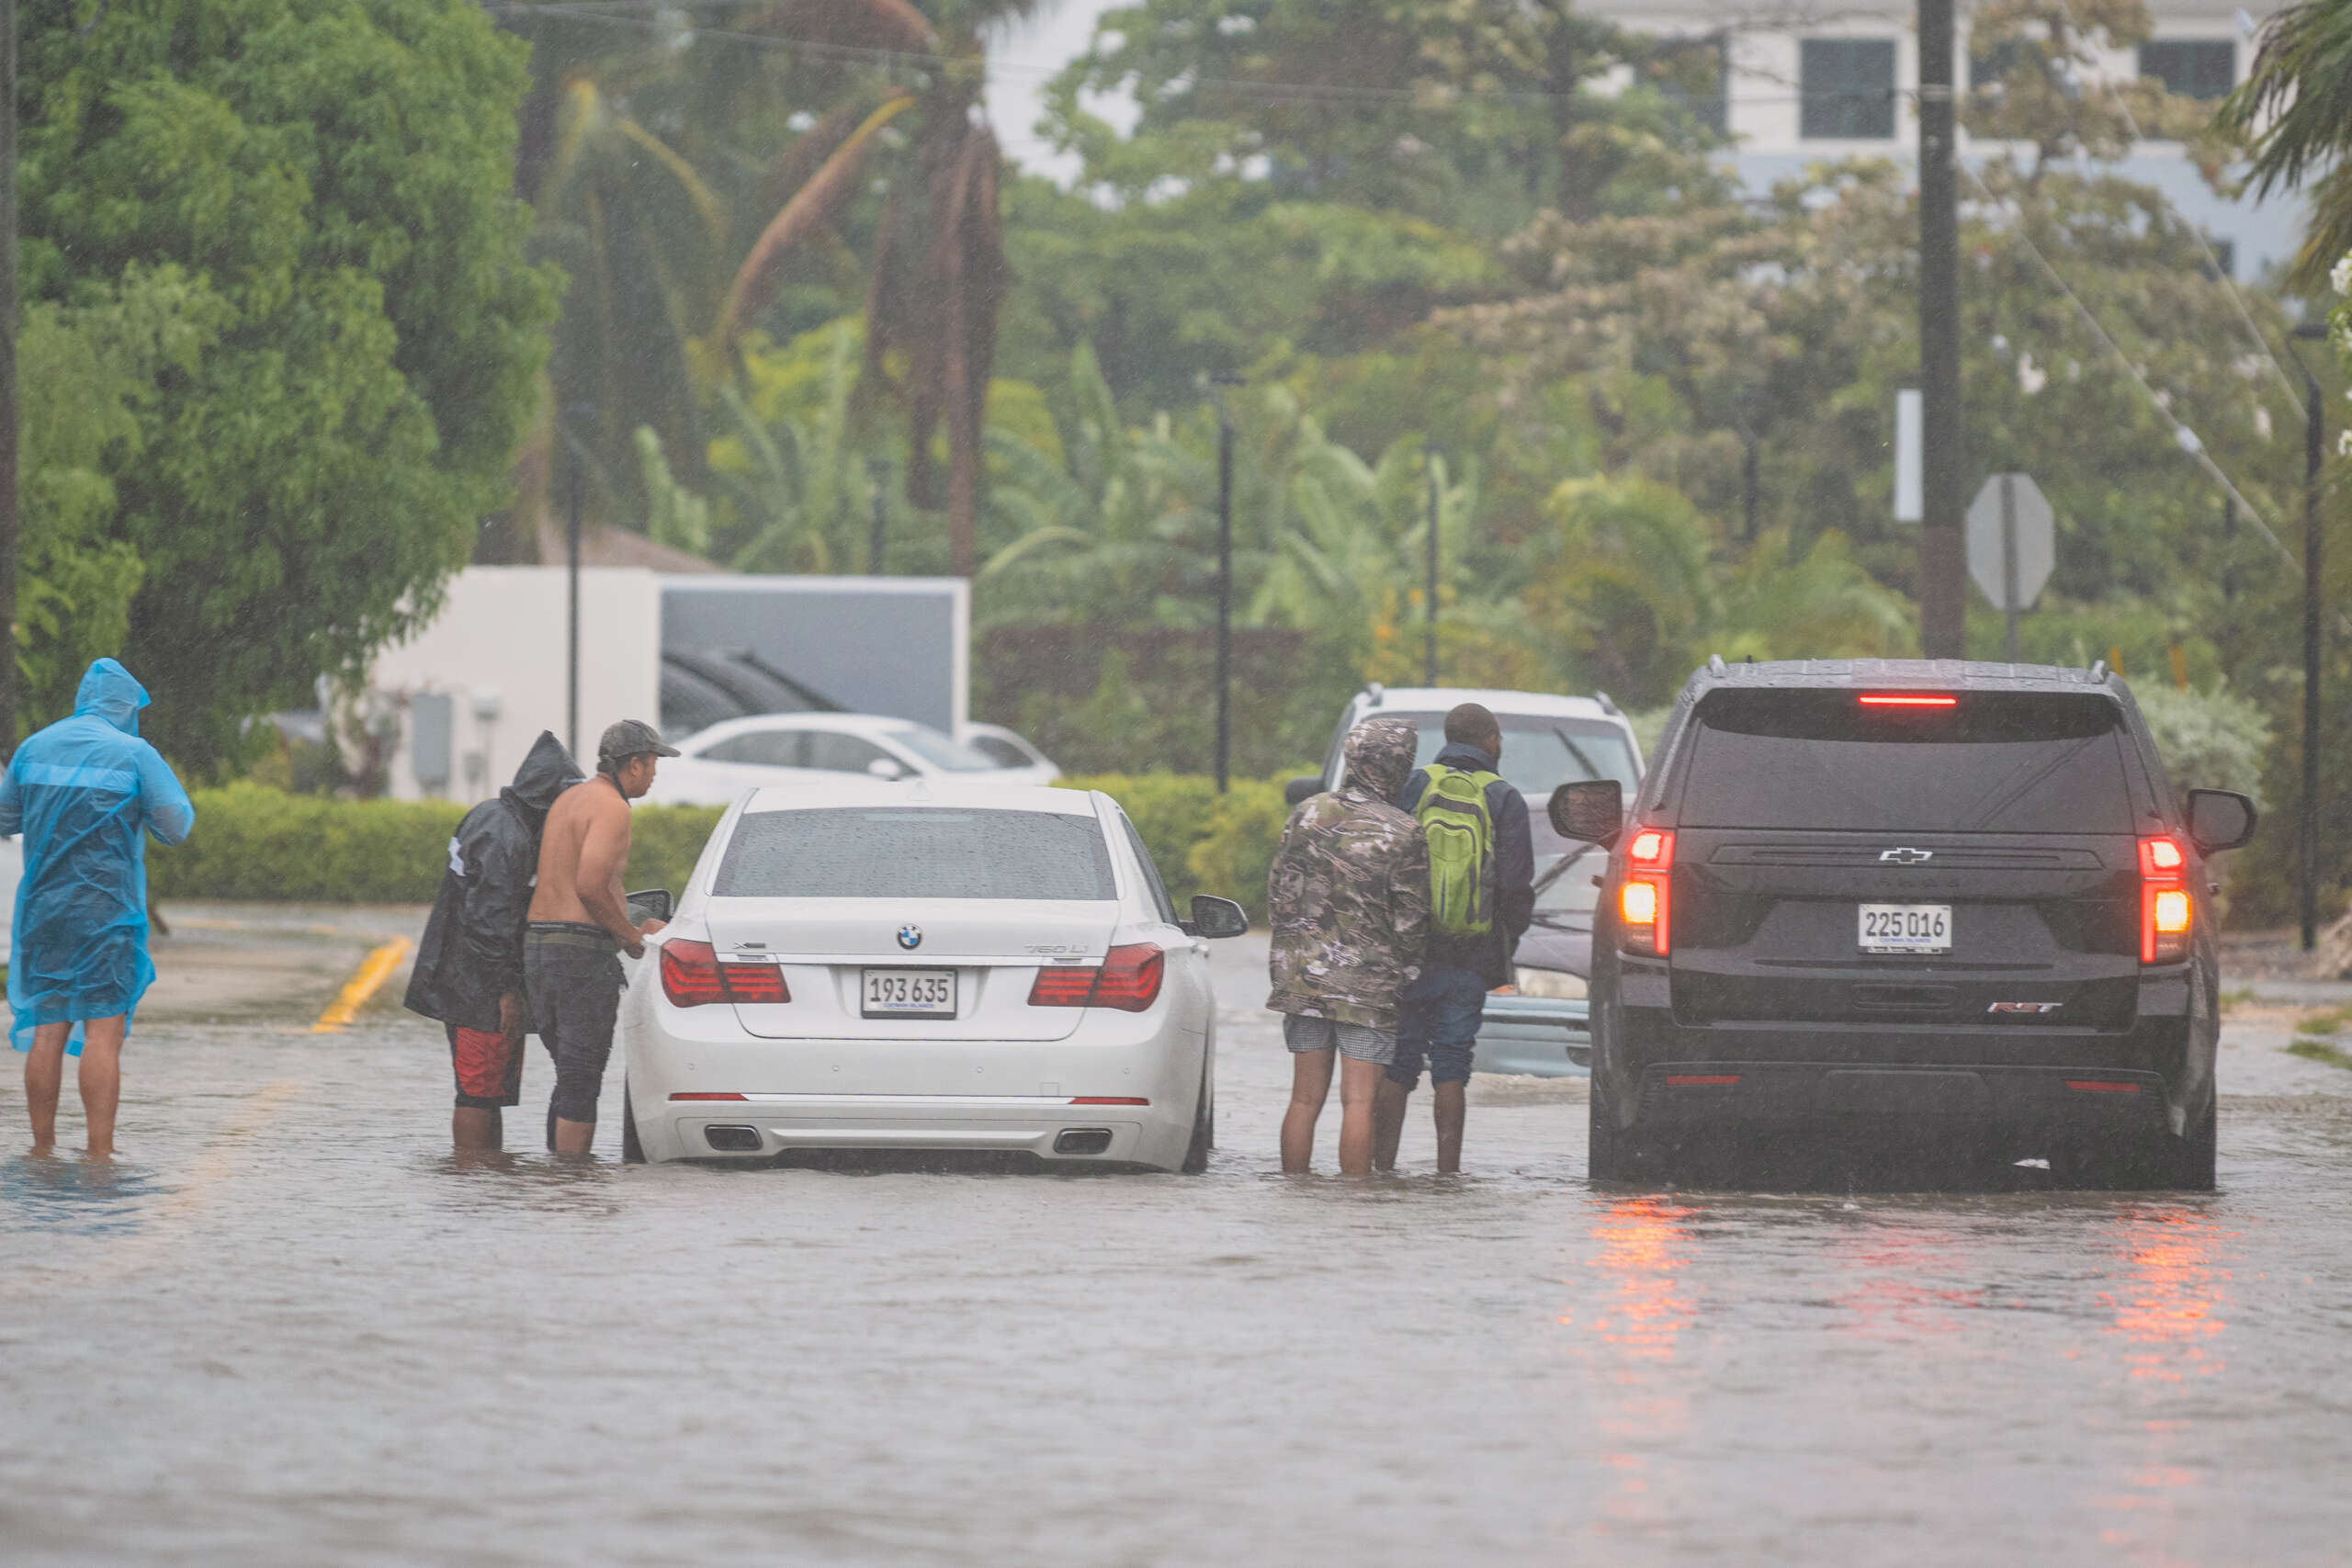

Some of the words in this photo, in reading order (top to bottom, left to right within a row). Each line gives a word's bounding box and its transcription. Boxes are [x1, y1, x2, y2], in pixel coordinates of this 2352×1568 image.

[1866, 911, 1903, 937] 225
[1907, 911, 1945, 937] 016
[869, 977, 907, 1002] 193
[911, 977, 949, 1003] 635
